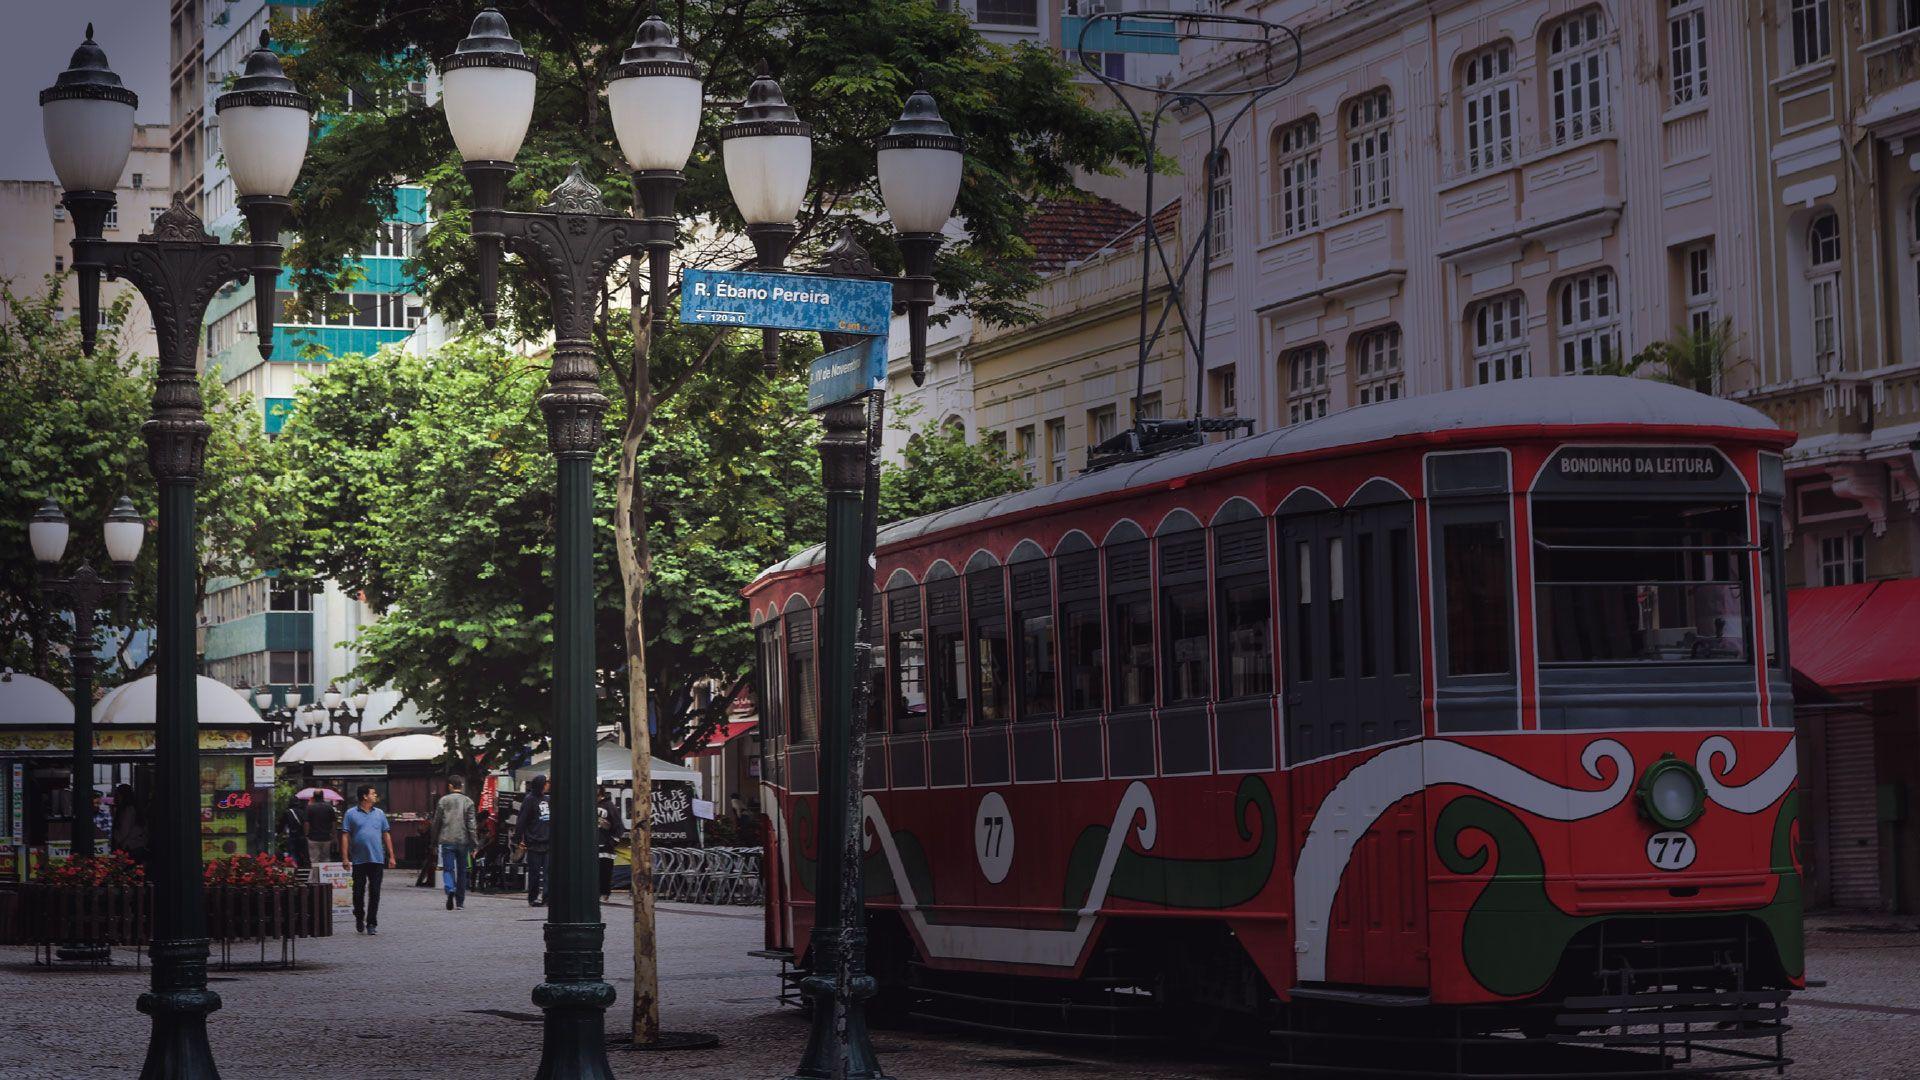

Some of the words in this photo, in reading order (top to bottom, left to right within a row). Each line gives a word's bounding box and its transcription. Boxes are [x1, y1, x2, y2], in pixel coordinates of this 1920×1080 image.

[694, 282, 711, 297] R.
[716, 280, 768, 300] Ébano
[773, 287, 830, 305] Pereira
[710, 313, 728, 322] 120
[1560, 457, 1631, 473] BONDINHO
[1635, 457, 1653, 473] DA
[1657, 457, 1714, 473] LEITURA
[671, 789, 685, 800] DE
[984, 816, 1003, 857] 77
[1654, 837, 1687, 863] 77
